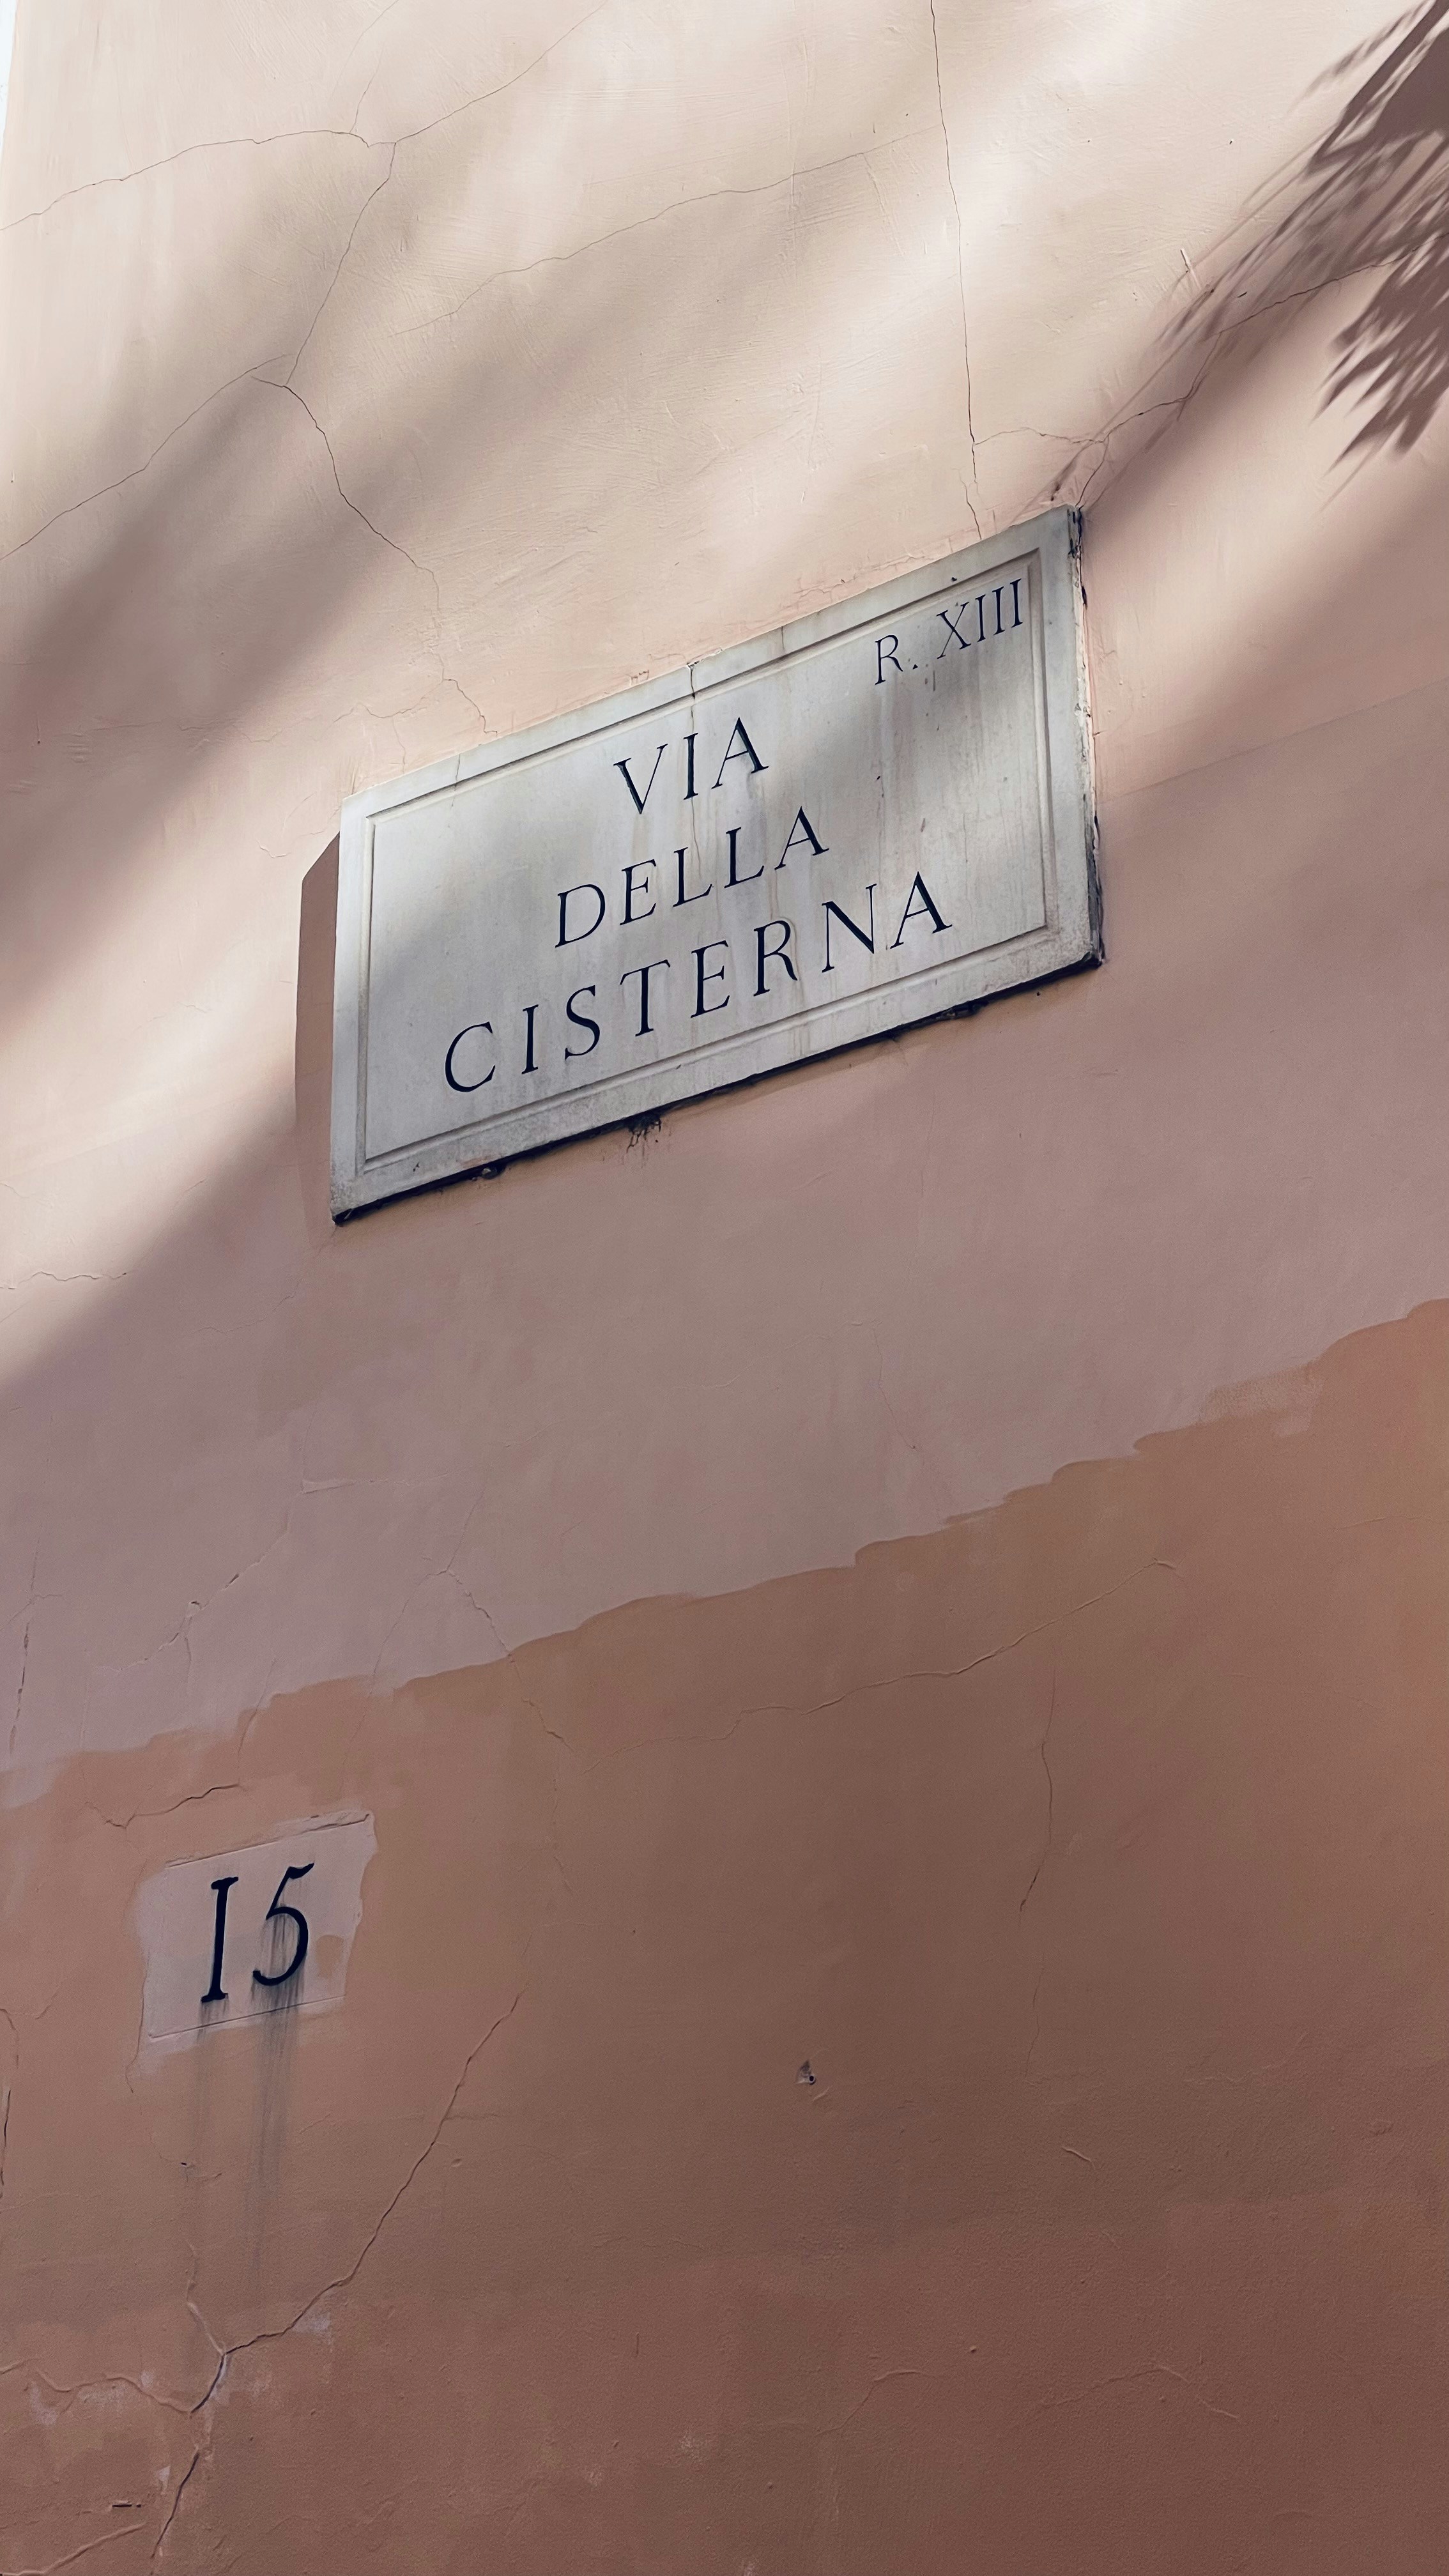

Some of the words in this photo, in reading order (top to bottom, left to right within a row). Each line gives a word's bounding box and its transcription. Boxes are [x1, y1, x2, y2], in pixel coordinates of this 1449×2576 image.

[875, 634, 918, 685] R.
[937, 578, 1023, 659] XIII
[613, 717, 769, 814] VIA
[555, 807, 829, 947] DELLA
[445, 872, 952, 1092] CISTERNA
[201, 1862, 314, 2004] 15
